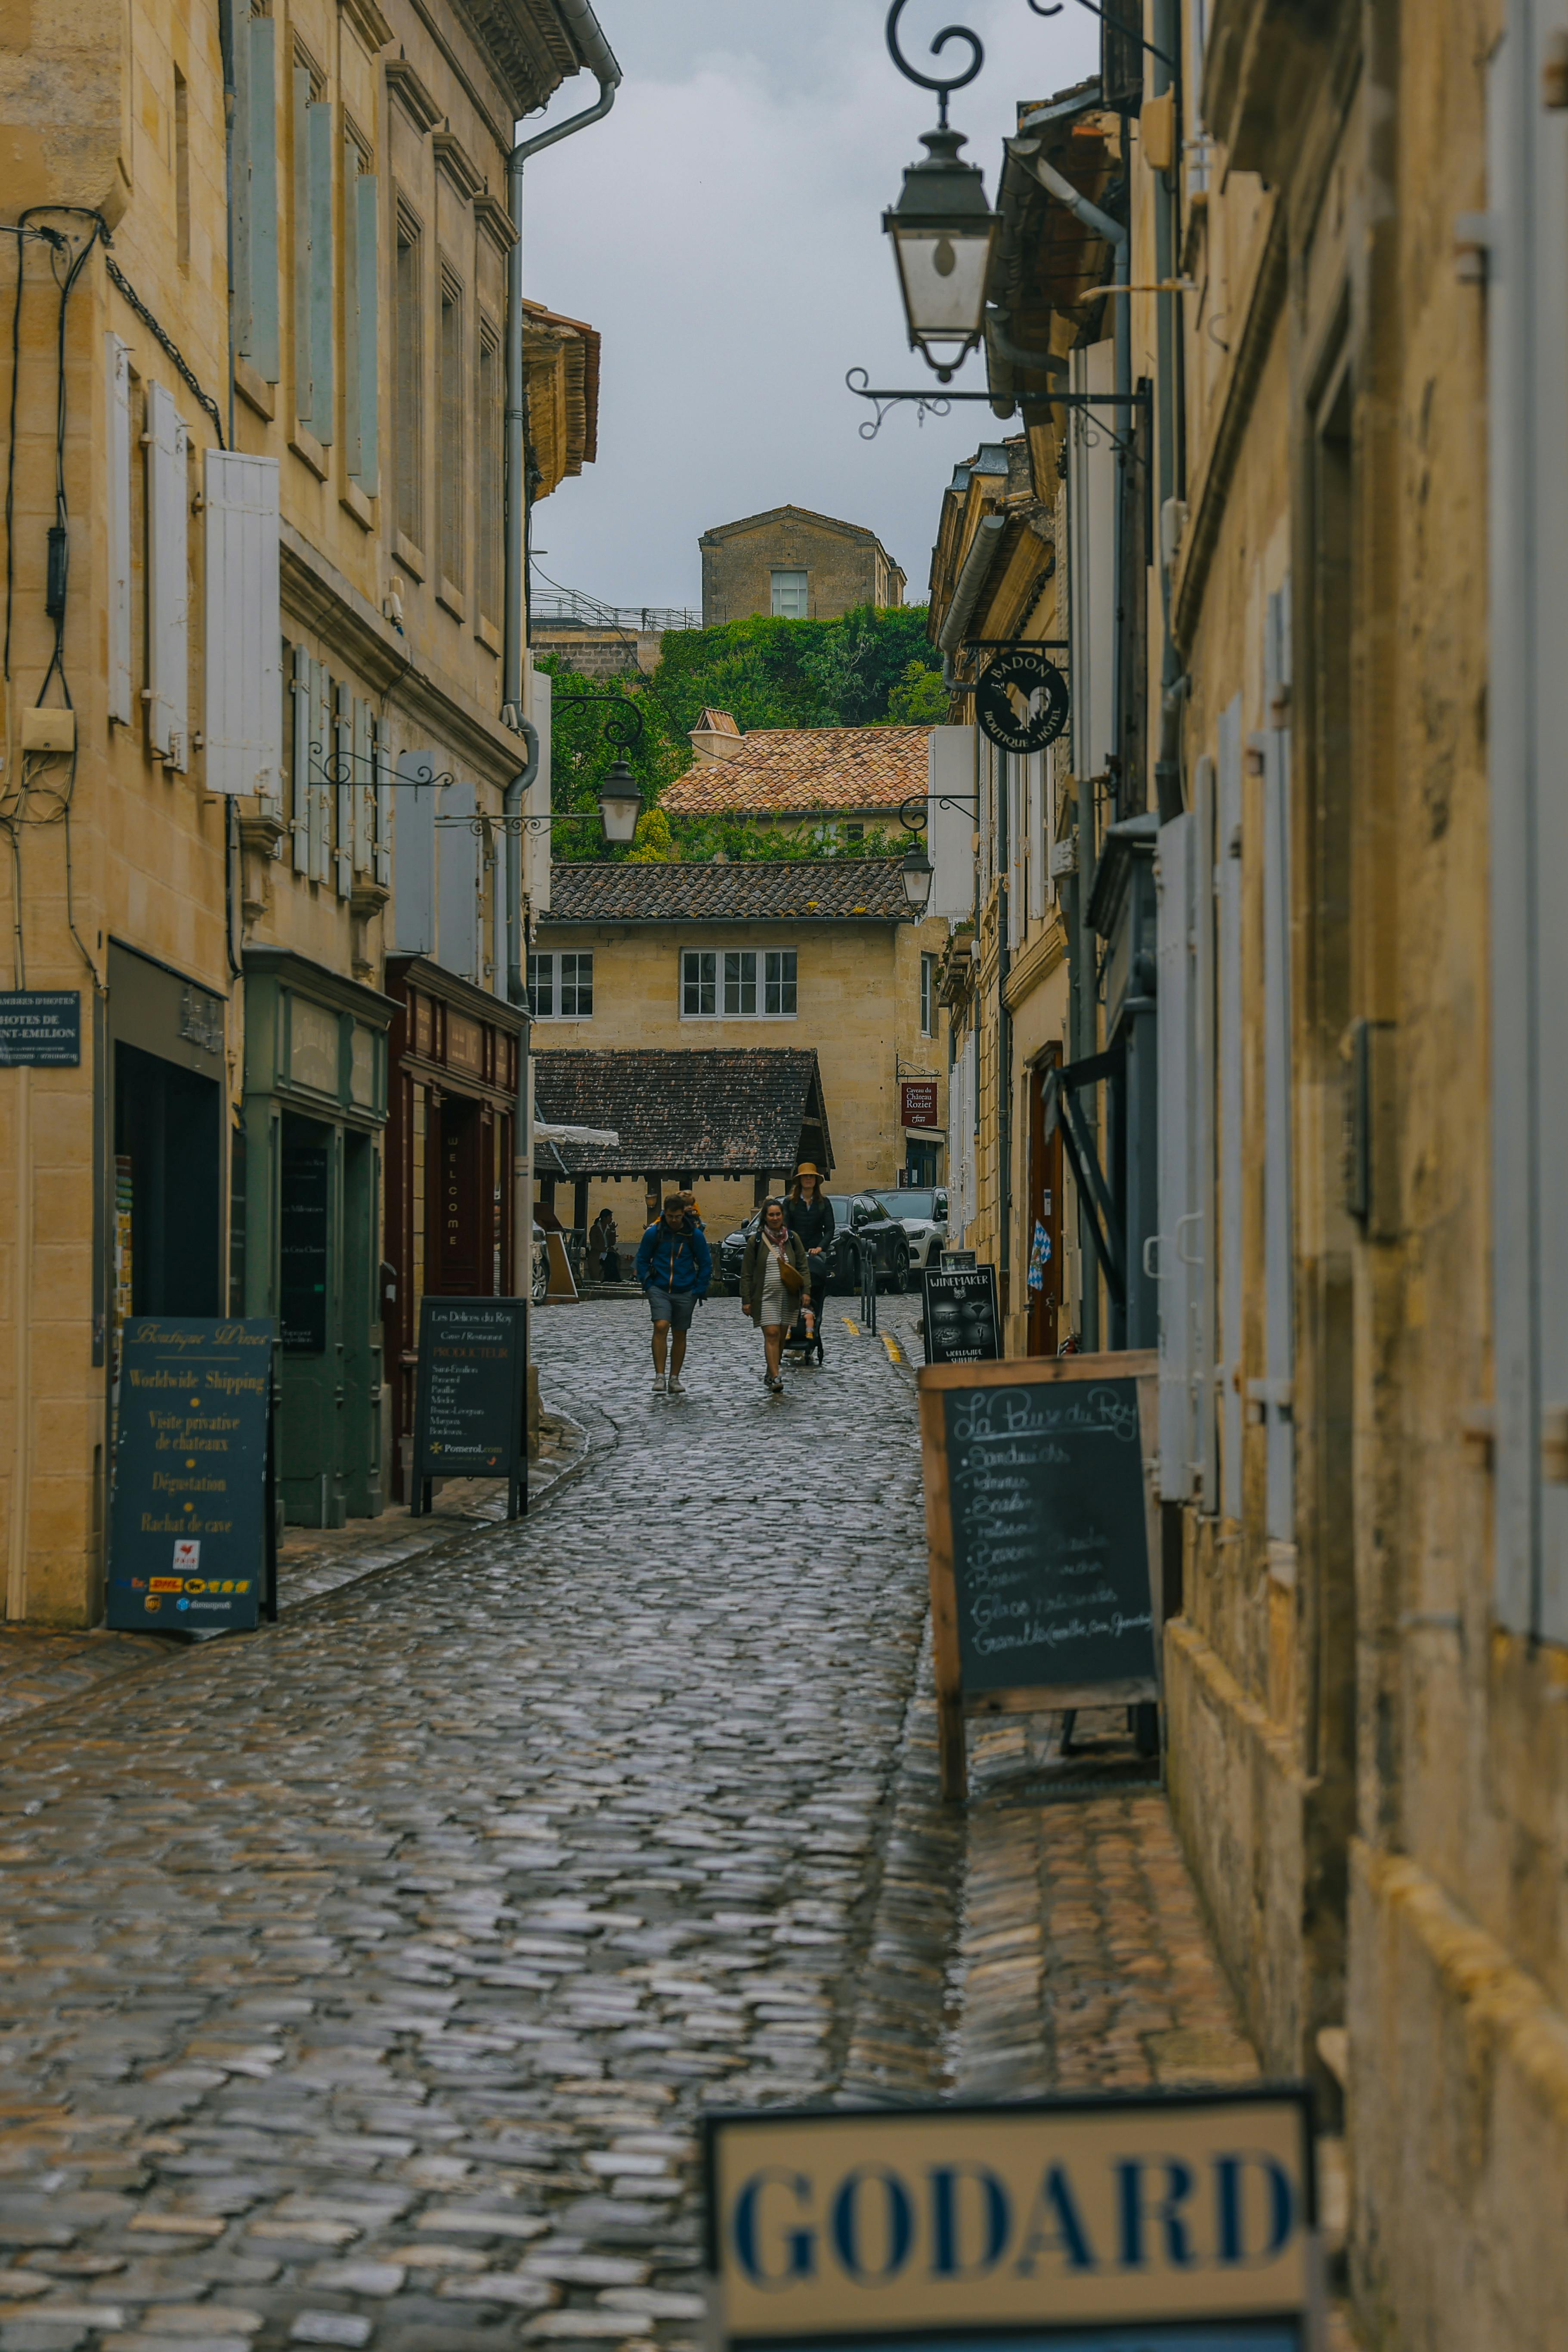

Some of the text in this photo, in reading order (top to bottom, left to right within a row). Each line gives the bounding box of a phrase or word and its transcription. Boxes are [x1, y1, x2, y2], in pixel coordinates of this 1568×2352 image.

[990, 656, 1050, 679] BADON
[984, 710, 1030, 749] BOUTIQUE
[1037, 707, 1061, 741] HÔTEL
[43, 1015, 60, 1025] DE
[906, 1100, 932, 1108] Rozier
[930, 1275, 988, 1287] WINEMAKER
[432, 1311, 448, 1321] Les
[481, 1312, 494, 1322] du
[495, 1312, 513, 1326] Roy
[130, 1323, 207, 1352] Boutique
[433, 1346, 509, 1358] PRODUCTEUR
[946, 1348, 983, 1357] WORLDWIDE
[130, 1369, 266, 1396] Worldwide Shipping
[149, 1410, 241, 1436] Visite privative
[954, 1392, 996, 1441] La
[1087, 1386, 1137, 1442] Roy
[155, 1431, 171, 1451] de
[445, 1443, 503, 1453] Pomerol.com
[152, 1471, 227, 1498] Dégustation
[141, 1511, 233, 1533] Rachat de cave
[152, 1580, 181, 1589] DHL
[729, 2146, 1299, 2293] GODARD
